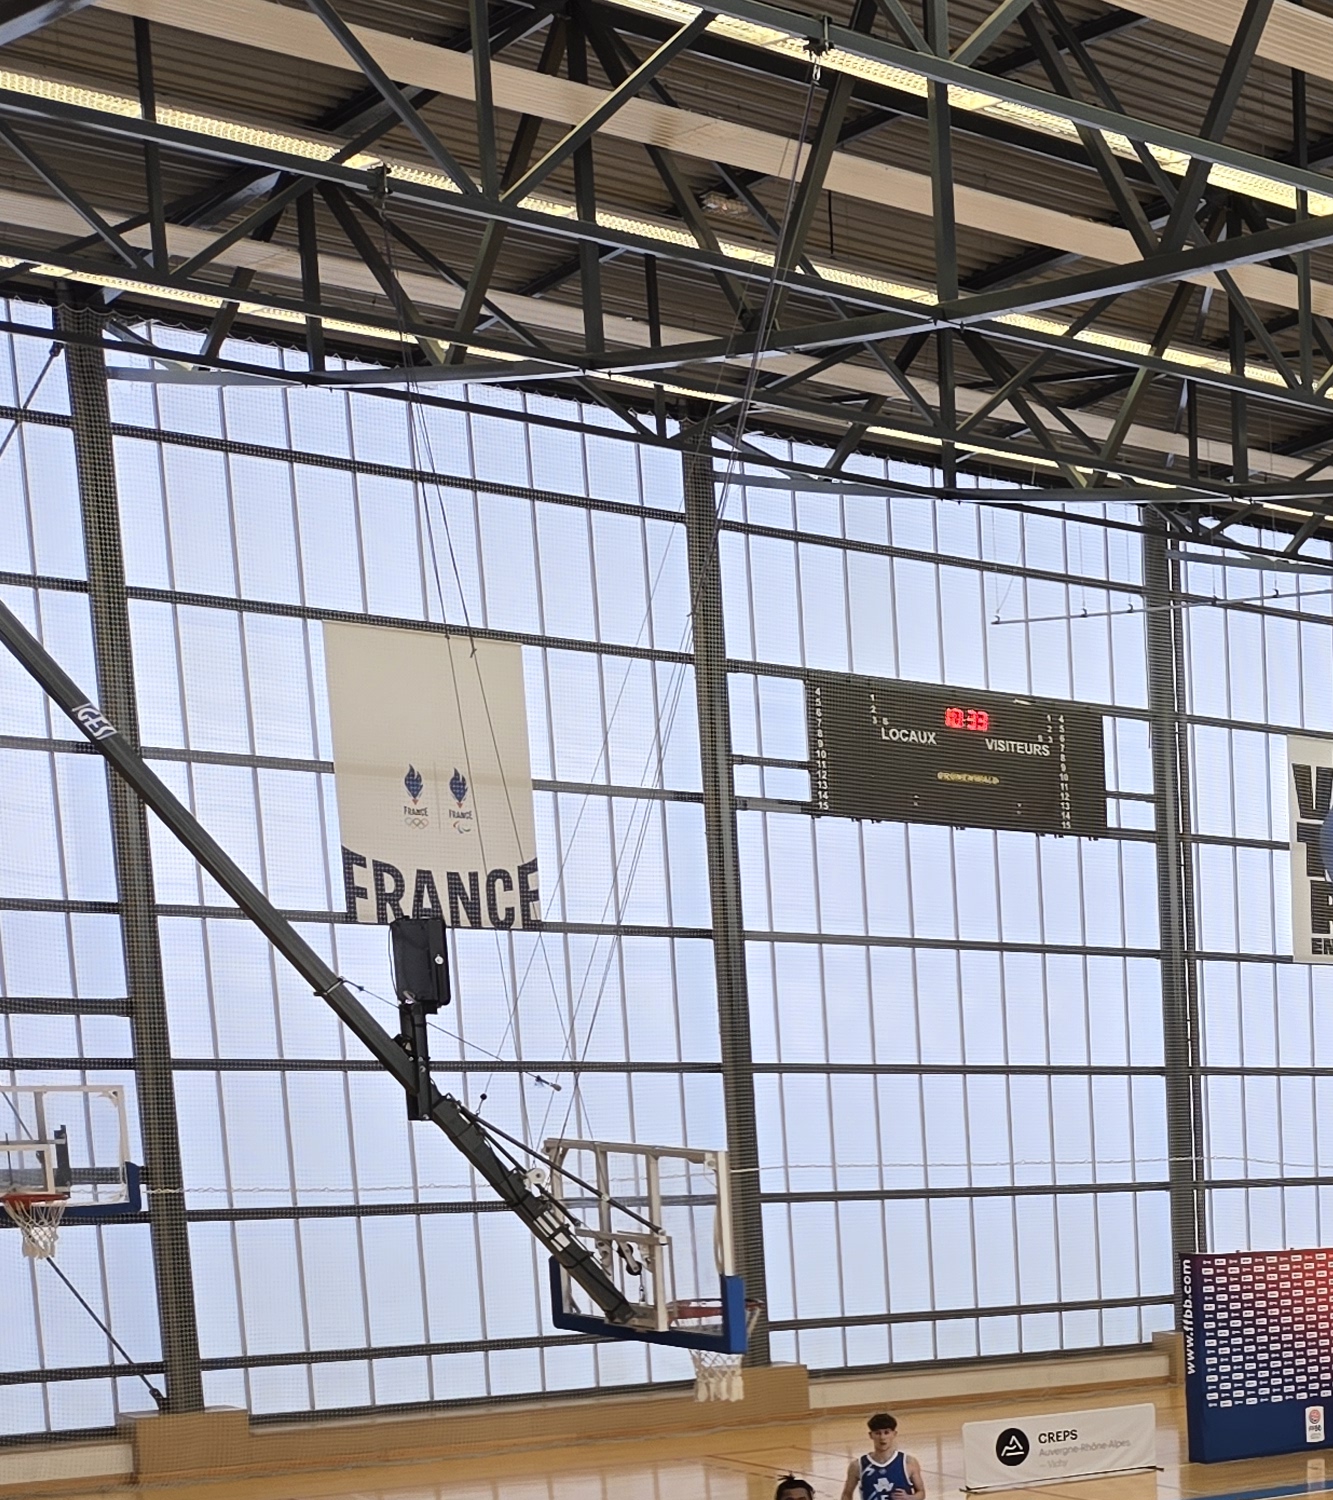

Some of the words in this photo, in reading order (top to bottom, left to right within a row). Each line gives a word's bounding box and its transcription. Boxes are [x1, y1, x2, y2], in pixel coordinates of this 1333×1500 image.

[881, 727, 937, 745] LOCAUX
[985, 738, 1050, 756] VISITEURS
[816, 750, 827, 758] 10
[816, 760, 827, 769] 11
[817, 770, 827, 779] 12
[1059, 773, 1069, 781] 10
[818, 780, 828, 789] 13
[1060, 783, 1068, 791] 11
[818, 790, 828, 799] 14
[1060, 792, 1070, 800] 12
[818, 801, 829, 810] 15
[1061, 802, 1070, 810] 13
[404, 806, 429, 817] FRANCE
[449, 809, 473, 820] FRANCE
[1061, 811, 1070, 820] 14
[1061, 821, 1071, 829] 15
[341, 845, 540, 930] FRANCE
[1182, 1259, 1196, 1375] www.ffbb.com
[1038, 1429, 1078, 1444] CREPS
